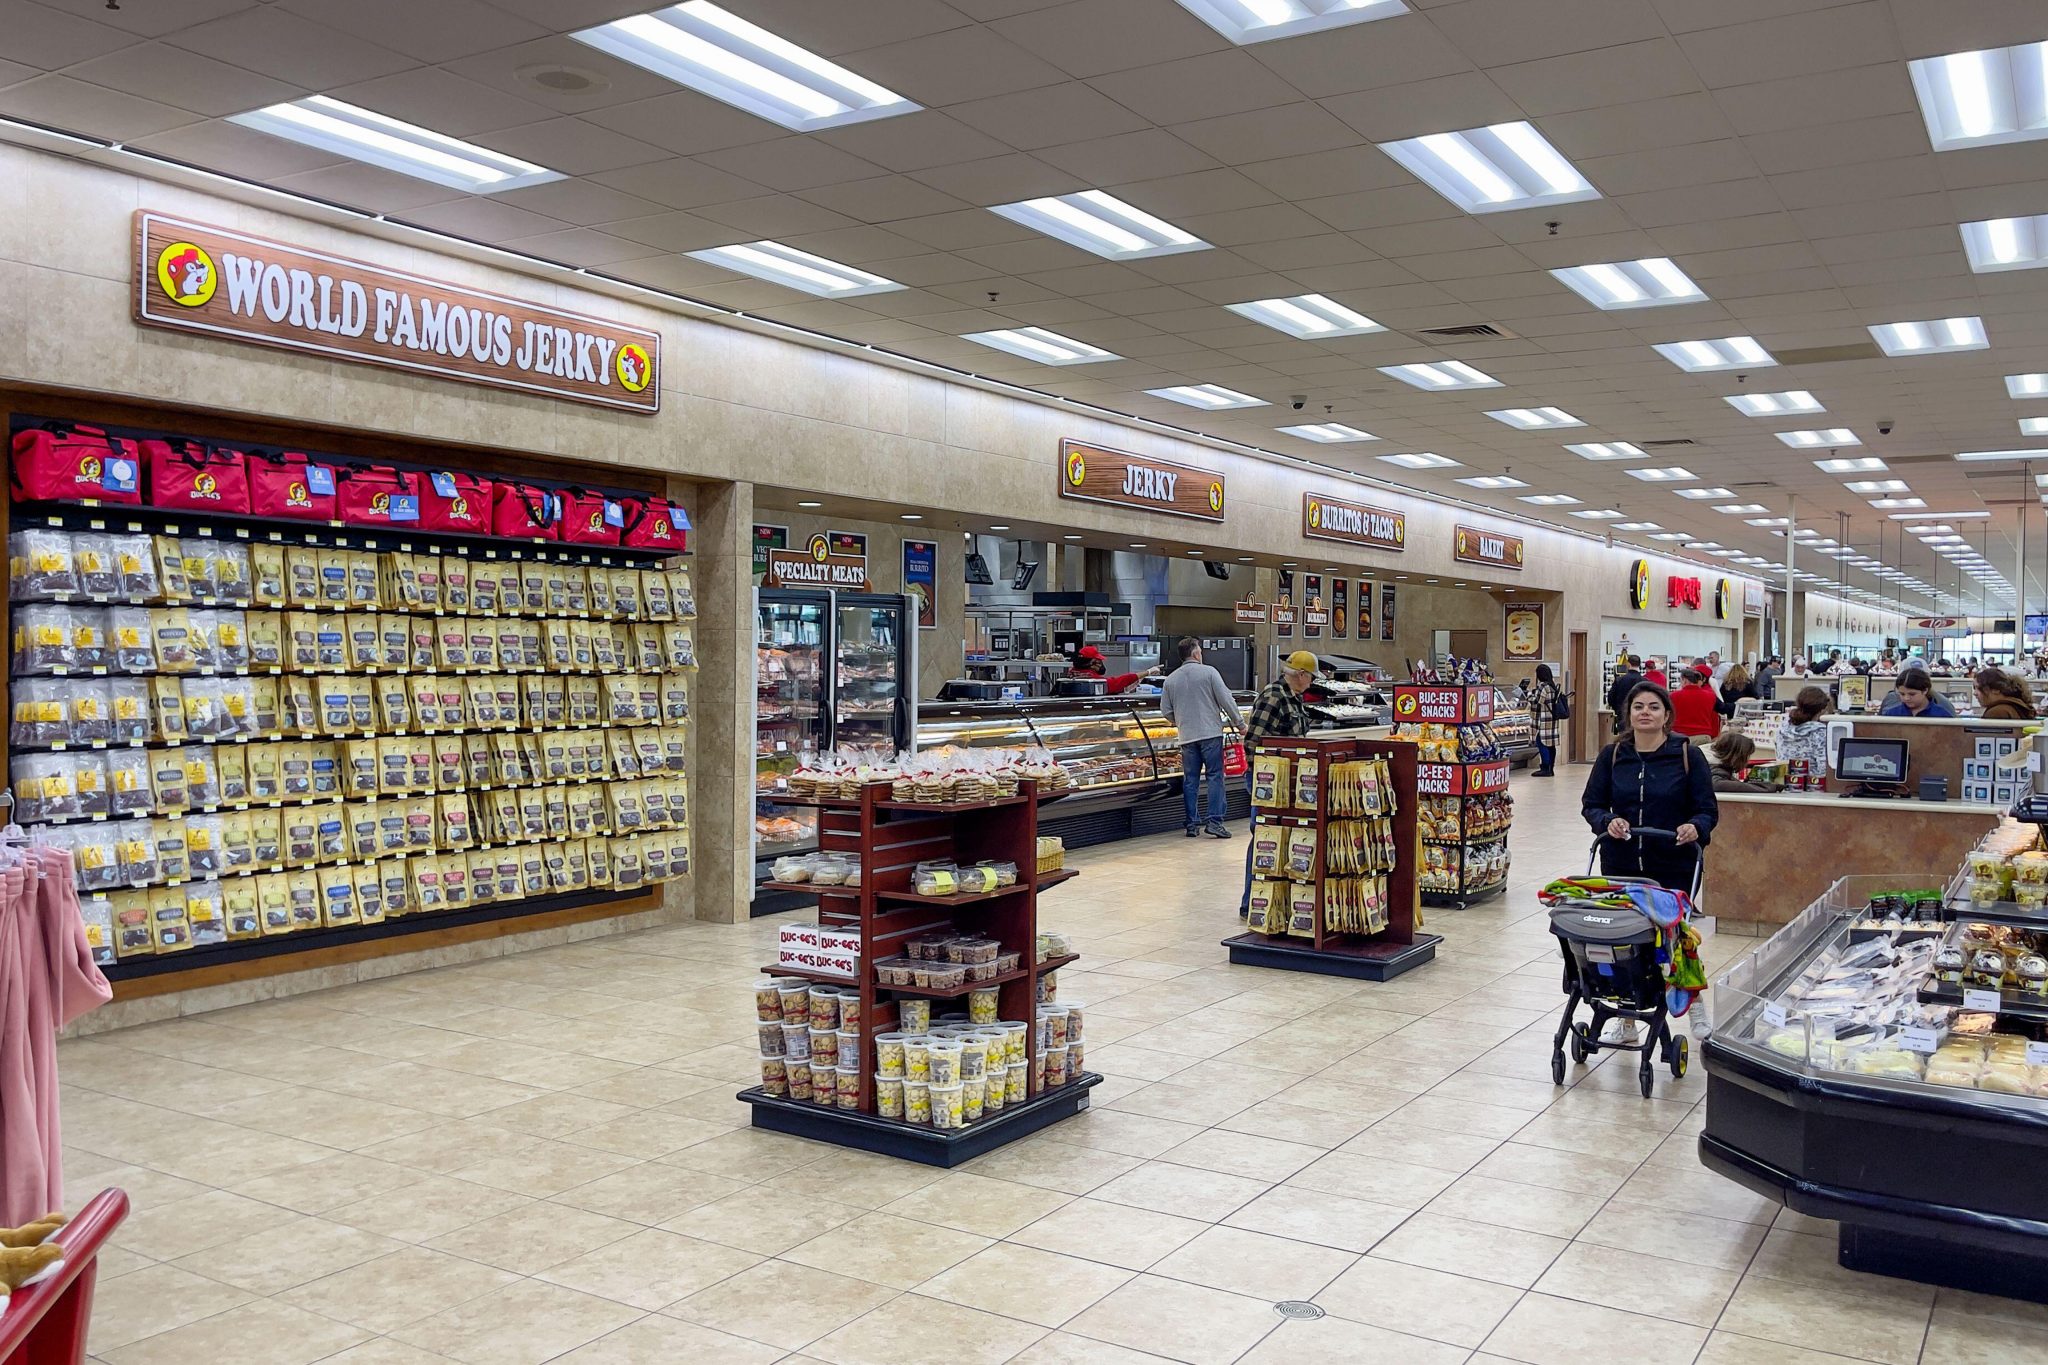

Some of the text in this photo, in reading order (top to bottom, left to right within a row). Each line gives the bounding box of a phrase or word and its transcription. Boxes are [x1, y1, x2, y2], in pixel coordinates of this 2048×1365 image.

[220, 252, 617, 386] WORLD FAMOUS JERKY
[1122, 463, 1179, 502] JERKY
[1321, 504, 1394, 541] BURRITOS & TACOS
[1479, 536, 1505, 560] BAKERY
[773, 561, 865, 584] SPECIALTY MEATS
[1418, 691, 1458, 705] BUC-EE'S
[1421, 705, 1456, 718] SNACKS
[1417, 764, 1453, 780] UC-EE'S
[1417, 779, 1450, 794] NACKS
[1583, 915, 1611, 924] doona
[781, 931, 817, 946] BUC-EE'S
[821, 937, 861, 953] BUC-EE'S
[780, 951, 815, 966] BUC-EE'S
[816, 956, 852, 972] BUC-EE'S
